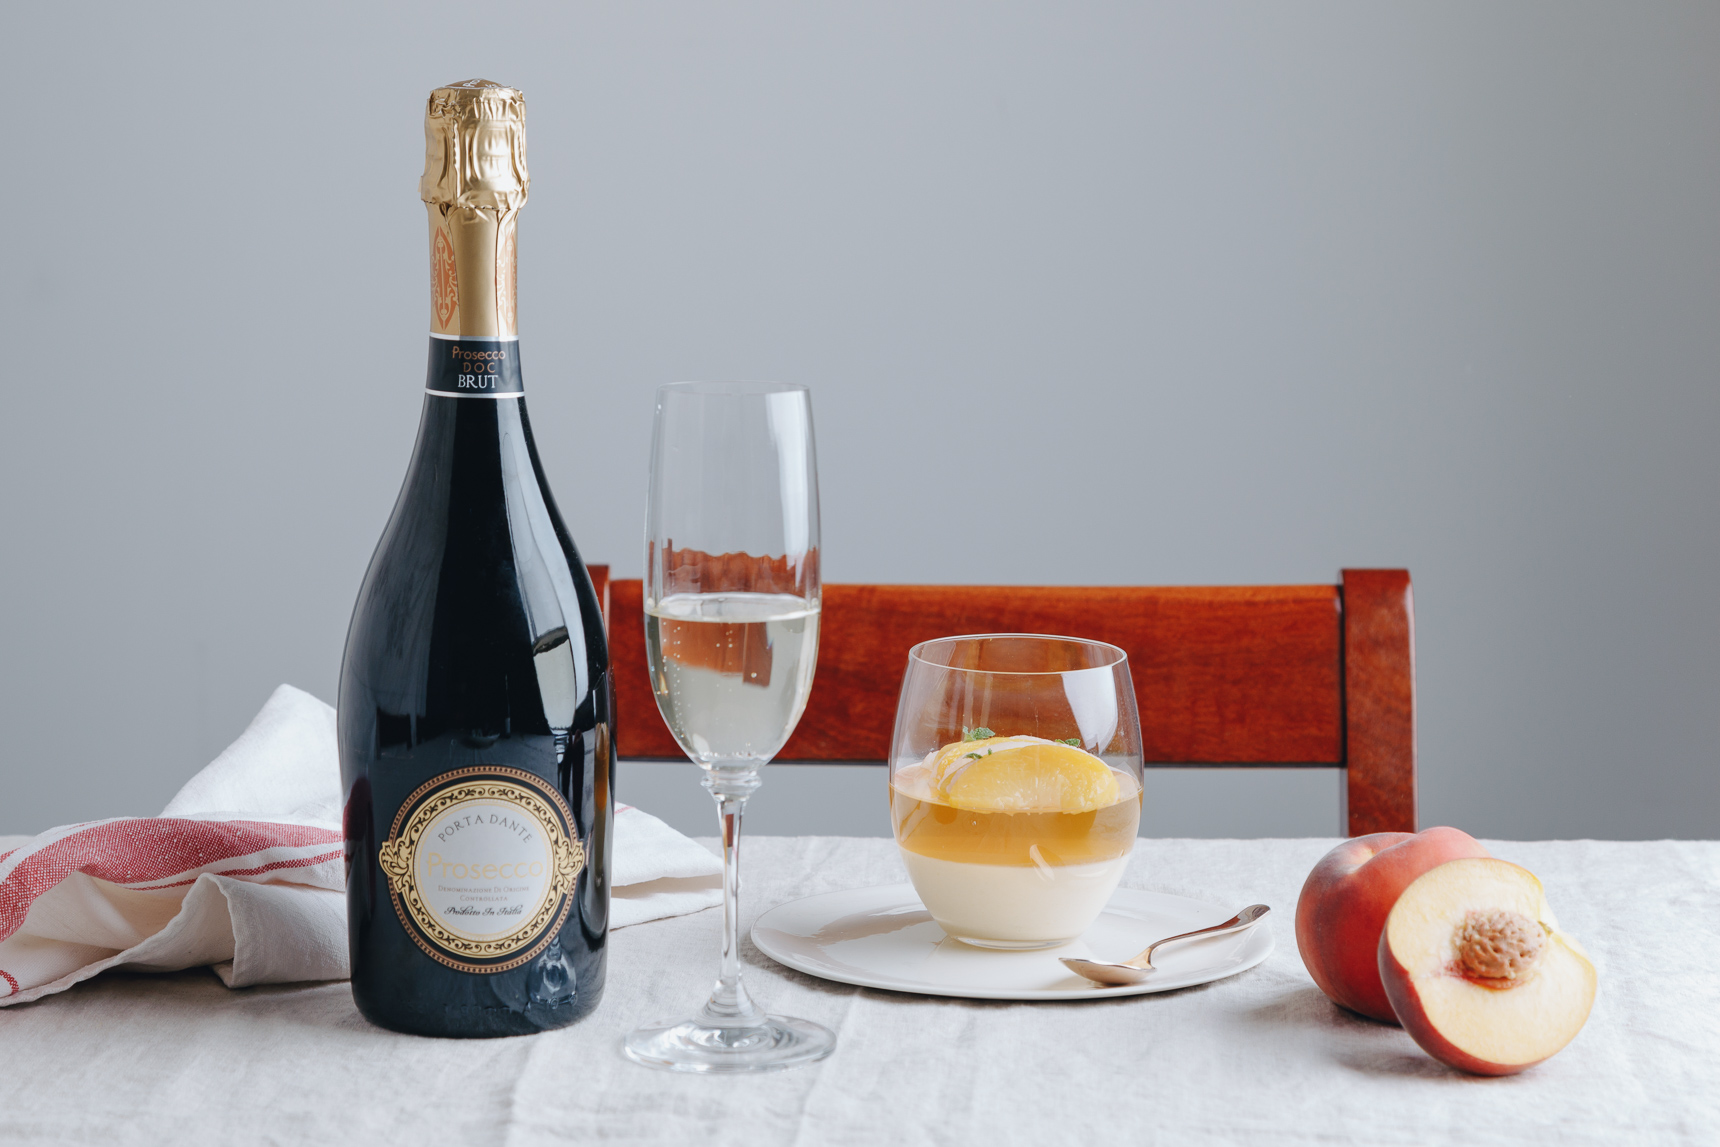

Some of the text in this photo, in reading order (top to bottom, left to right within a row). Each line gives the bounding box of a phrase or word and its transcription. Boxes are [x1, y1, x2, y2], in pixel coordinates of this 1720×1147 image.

[452, 345, 506, 360] Prosecco
[457, 374, 499, 389] BRUT
[437, 813, 533, 844] PORTA DANTE
[426, 851, 544, 880] Prosecco
[443, 904, 524, 917] Prodotto In Italia
